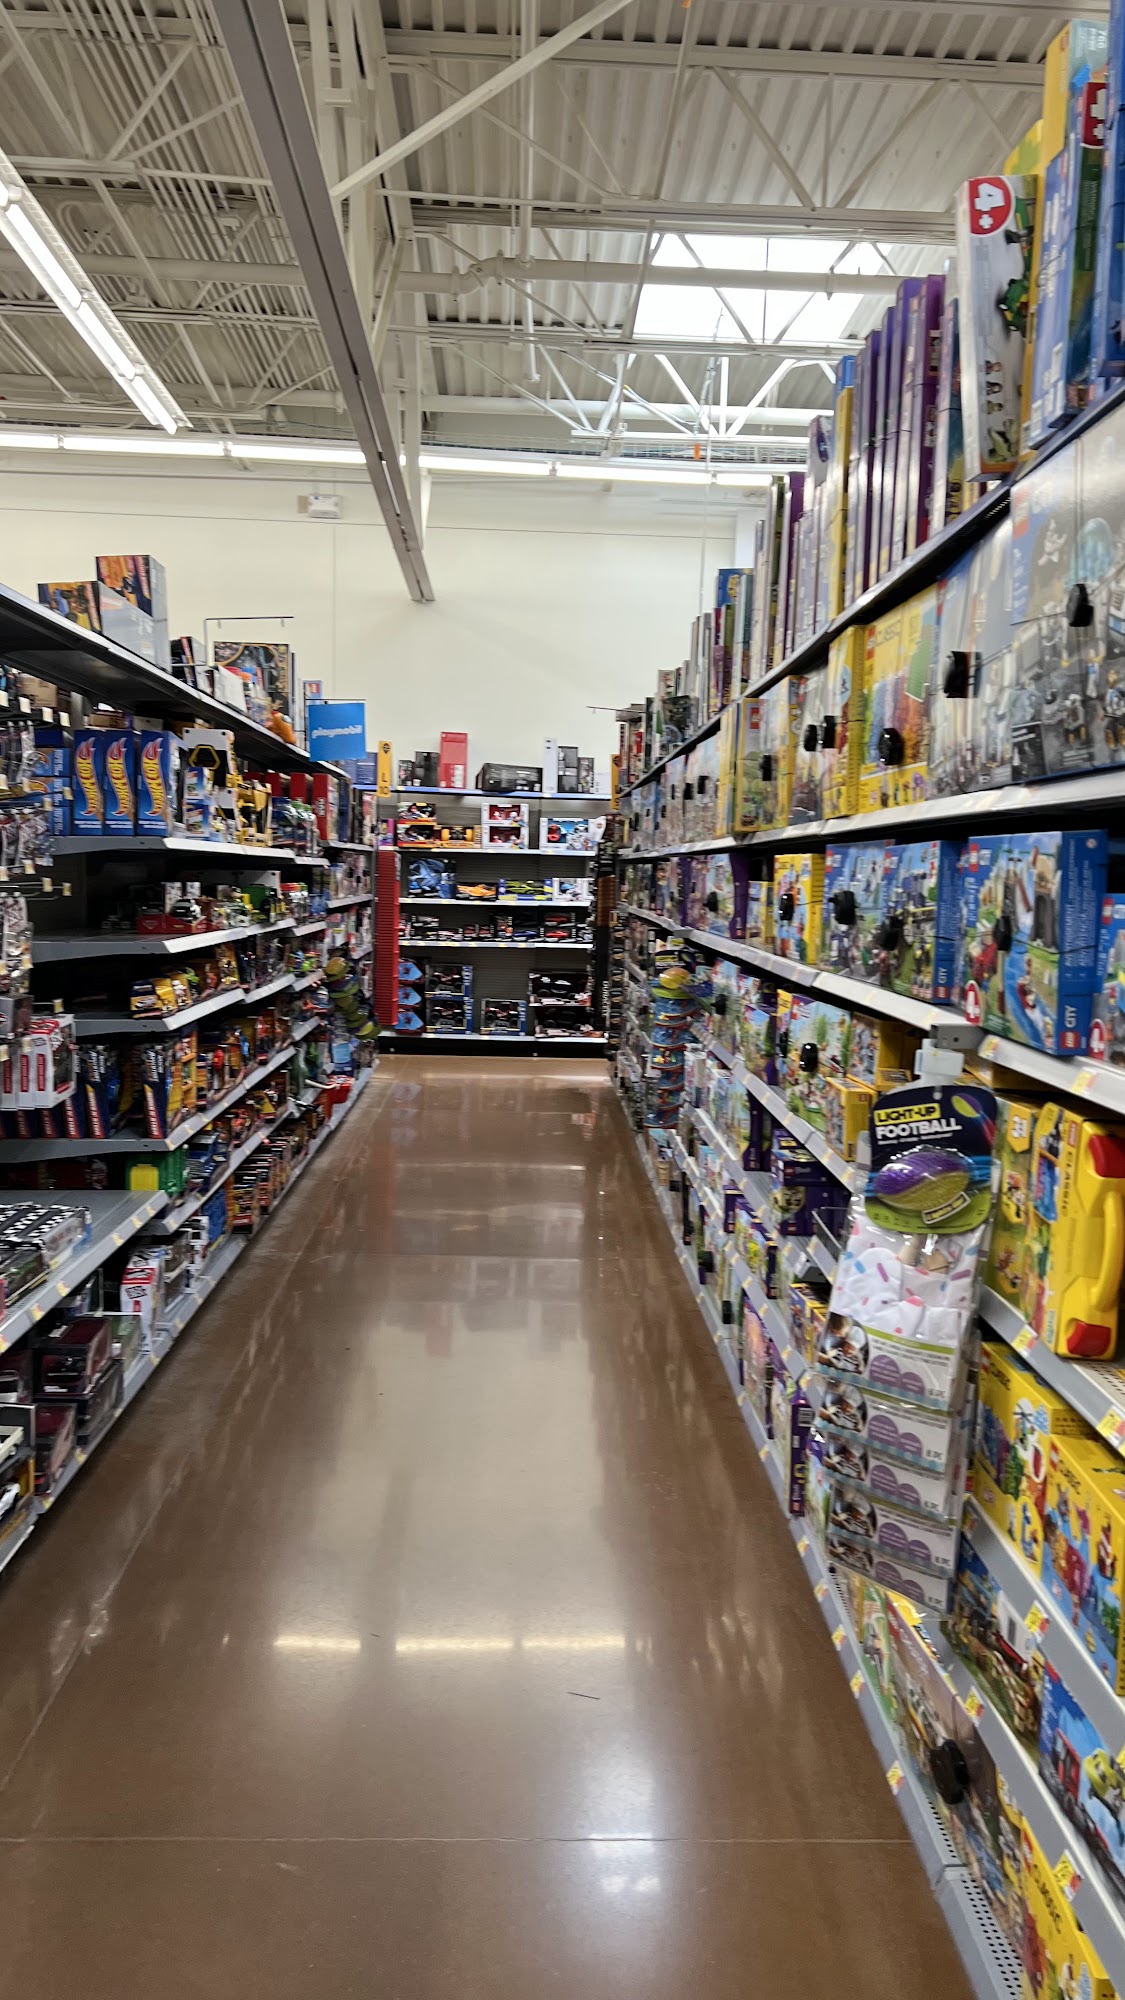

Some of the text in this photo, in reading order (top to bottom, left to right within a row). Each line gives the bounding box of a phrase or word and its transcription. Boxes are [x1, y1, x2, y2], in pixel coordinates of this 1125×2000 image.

[1064, 1005, 1077, 1027] CITY
[877, 1106, 936, 1122] LIGHT-UP
[875, 1117, 963, 1140] FOOTBALL
